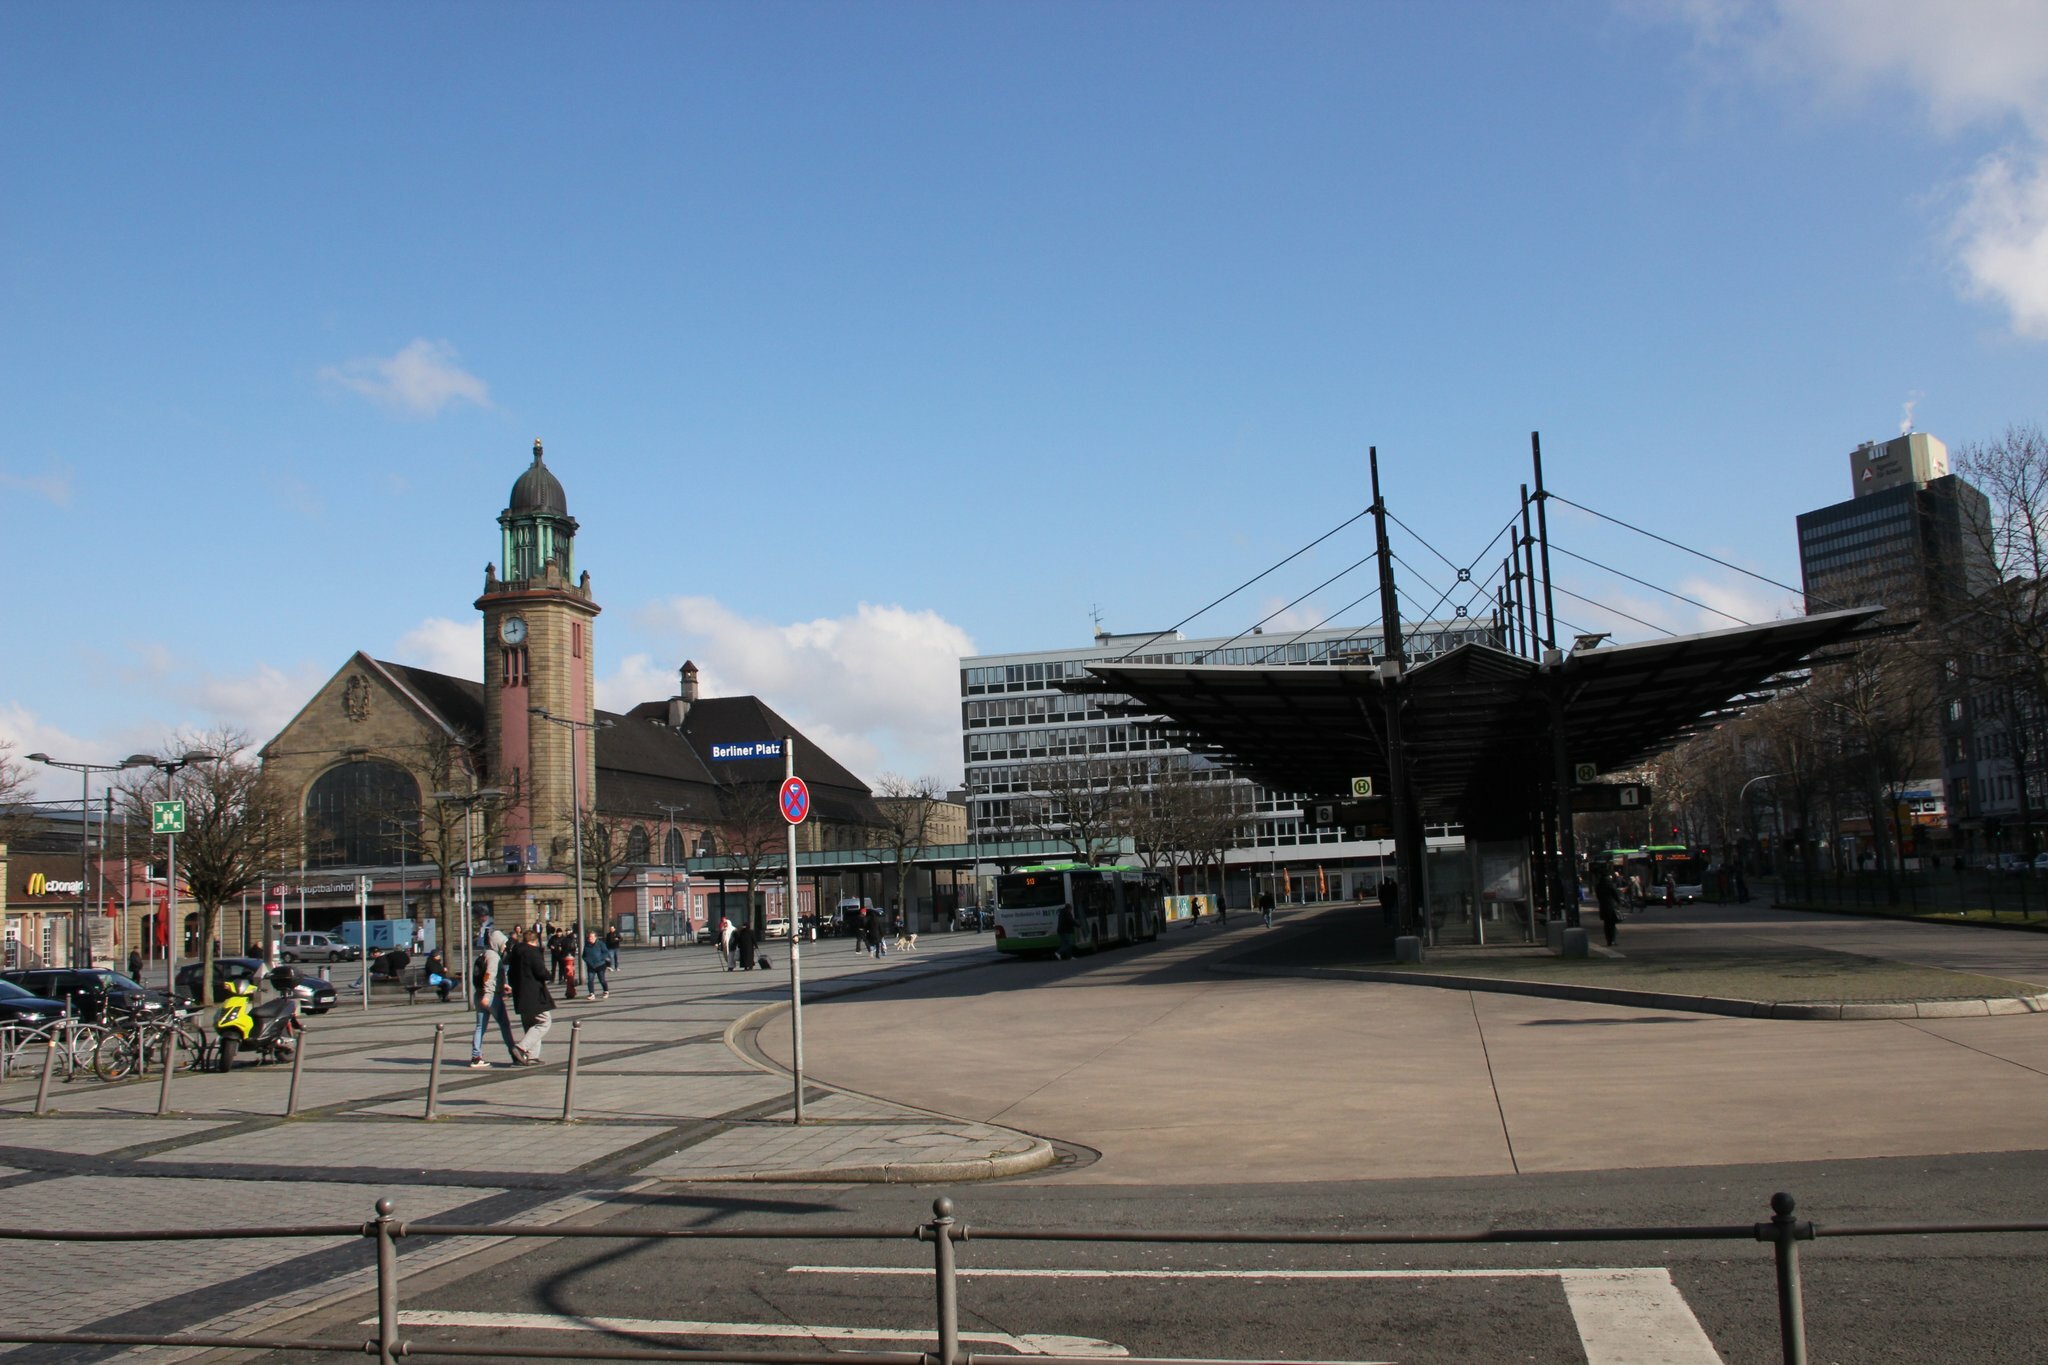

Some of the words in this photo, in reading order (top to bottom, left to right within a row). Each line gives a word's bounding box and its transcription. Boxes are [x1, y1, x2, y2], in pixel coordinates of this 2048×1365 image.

[713, 745, 753, 758] Berliner
[756, 743, 780, 755] Platz
[1625, 790, 1633, 803] 1
[1320, 808, 1329, 820] 6
[28, 873, 90, 895] McDonald
[296, 882, 355, 895] Hauptbahnhof
